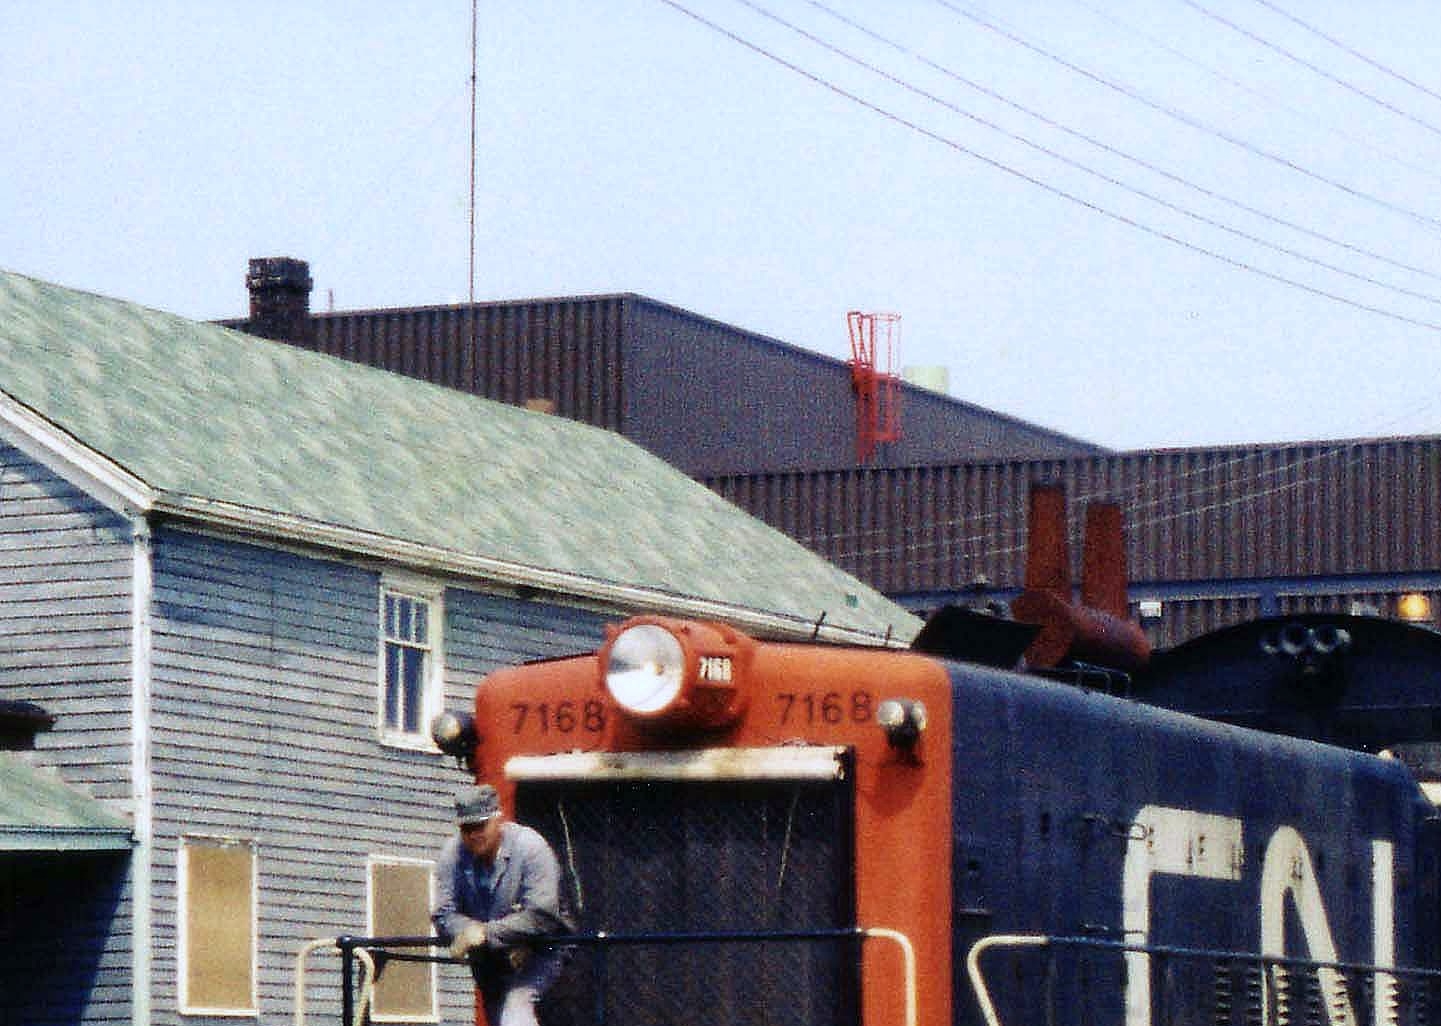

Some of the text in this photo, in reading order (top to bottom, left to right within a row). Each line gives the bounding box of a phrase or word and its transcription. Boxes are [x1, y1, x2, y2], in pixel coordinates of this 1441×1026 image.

[699, 656, 732, 681] 7168
[508, 699, 607, 736] 7168
[776, 691, 873, 727] 7168
